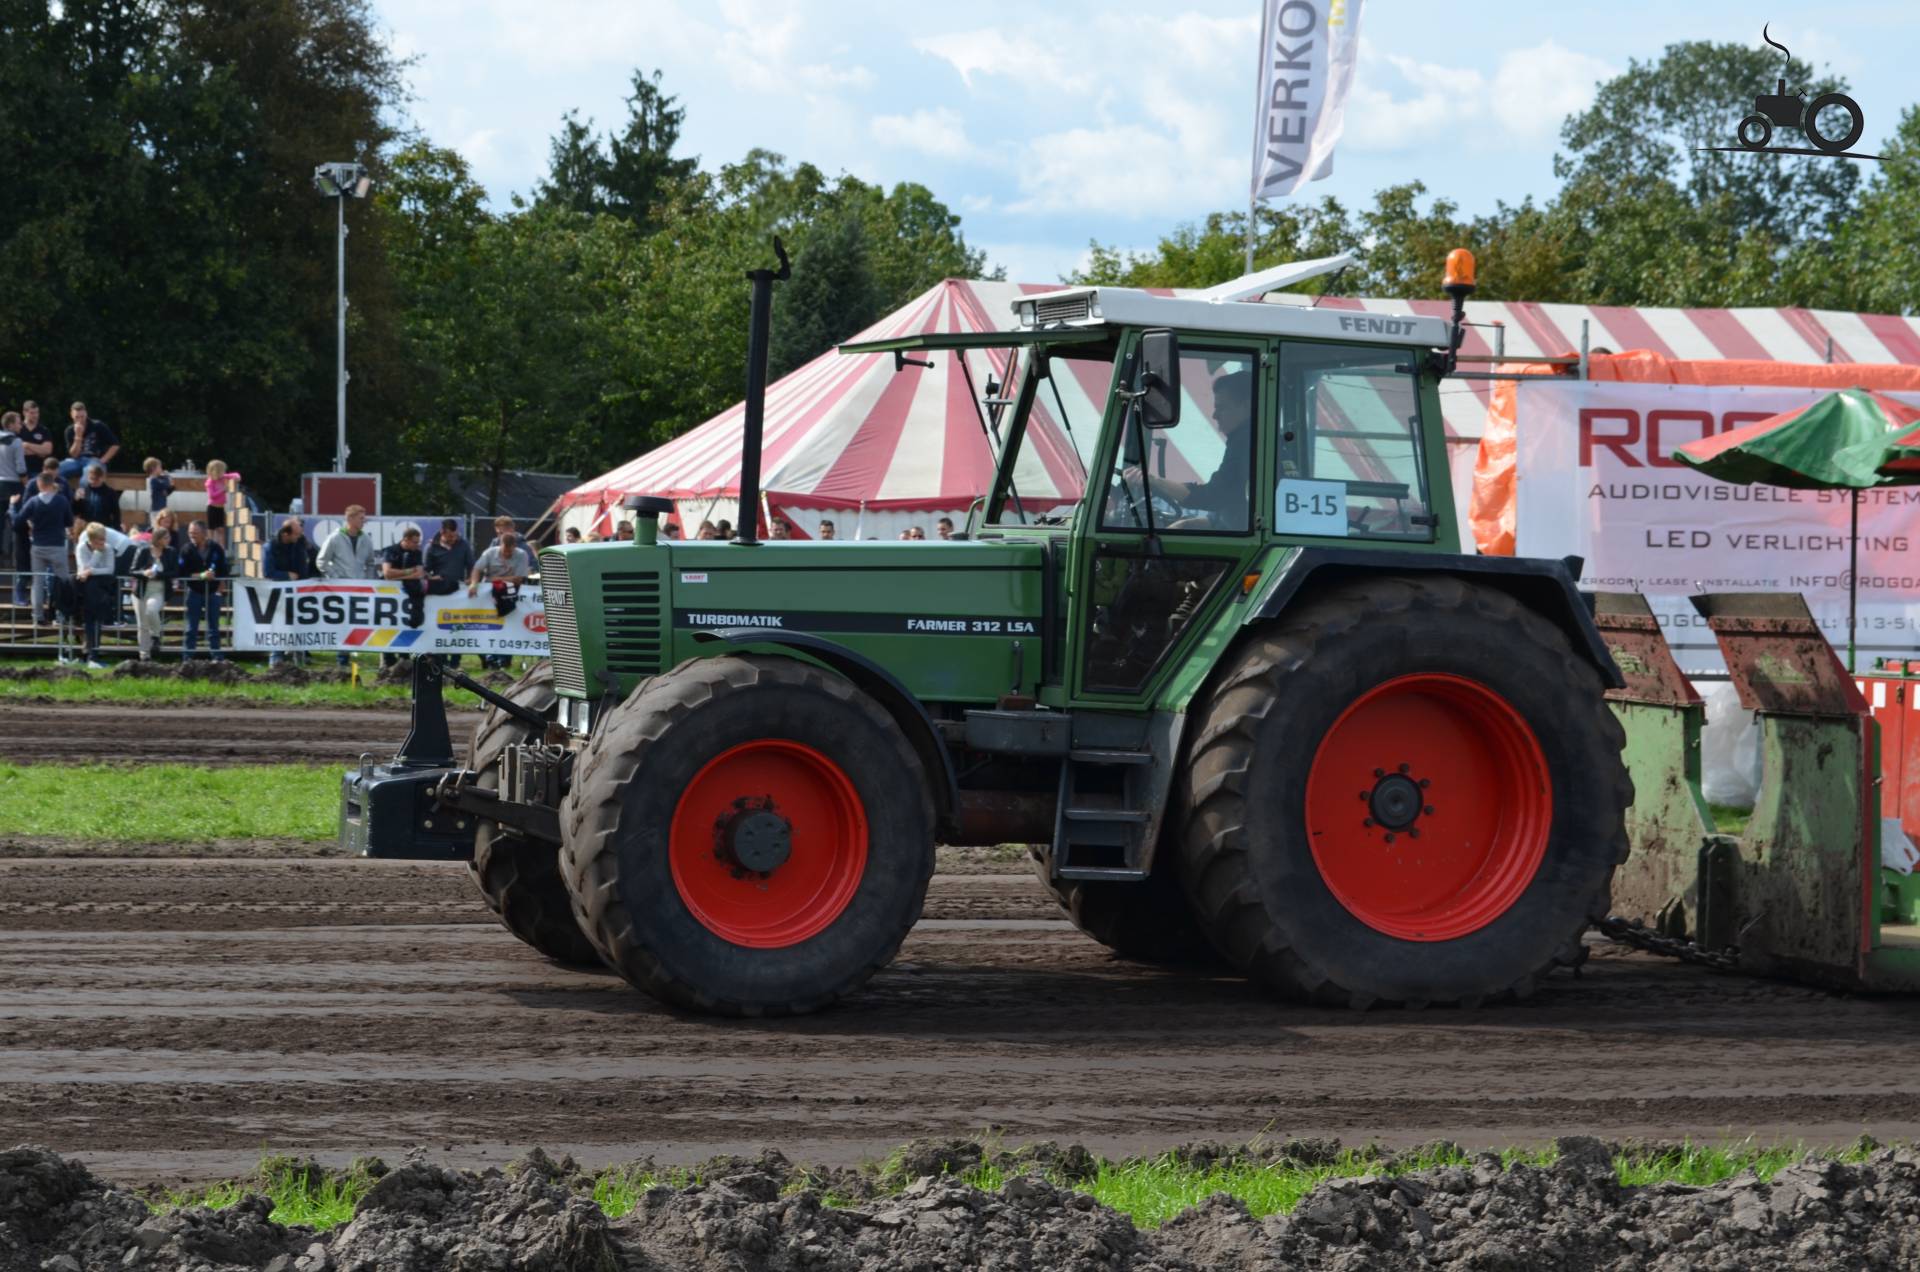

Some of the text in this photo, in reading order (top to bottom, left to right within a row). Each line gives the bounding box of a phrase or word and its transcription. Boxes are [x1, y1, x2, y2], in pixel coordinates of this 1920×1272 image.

[1339, 316, 1417, 336] FENDT
[1588, 484, 1803, 502] AUDIOVISUELE
[1284, 492, 1338, 517] B-15
[1646, 529, 1712, 549] LED
[1650, 578, 1688, 586] LEASE
[688, 614, 782, 627] TURBOMATIK
[907, 619, 1034, 633] FARMER 312 LSA
[255, 632, 337, 646] MECHANISATIE
[435, 639, 480, 648] BLADEL
